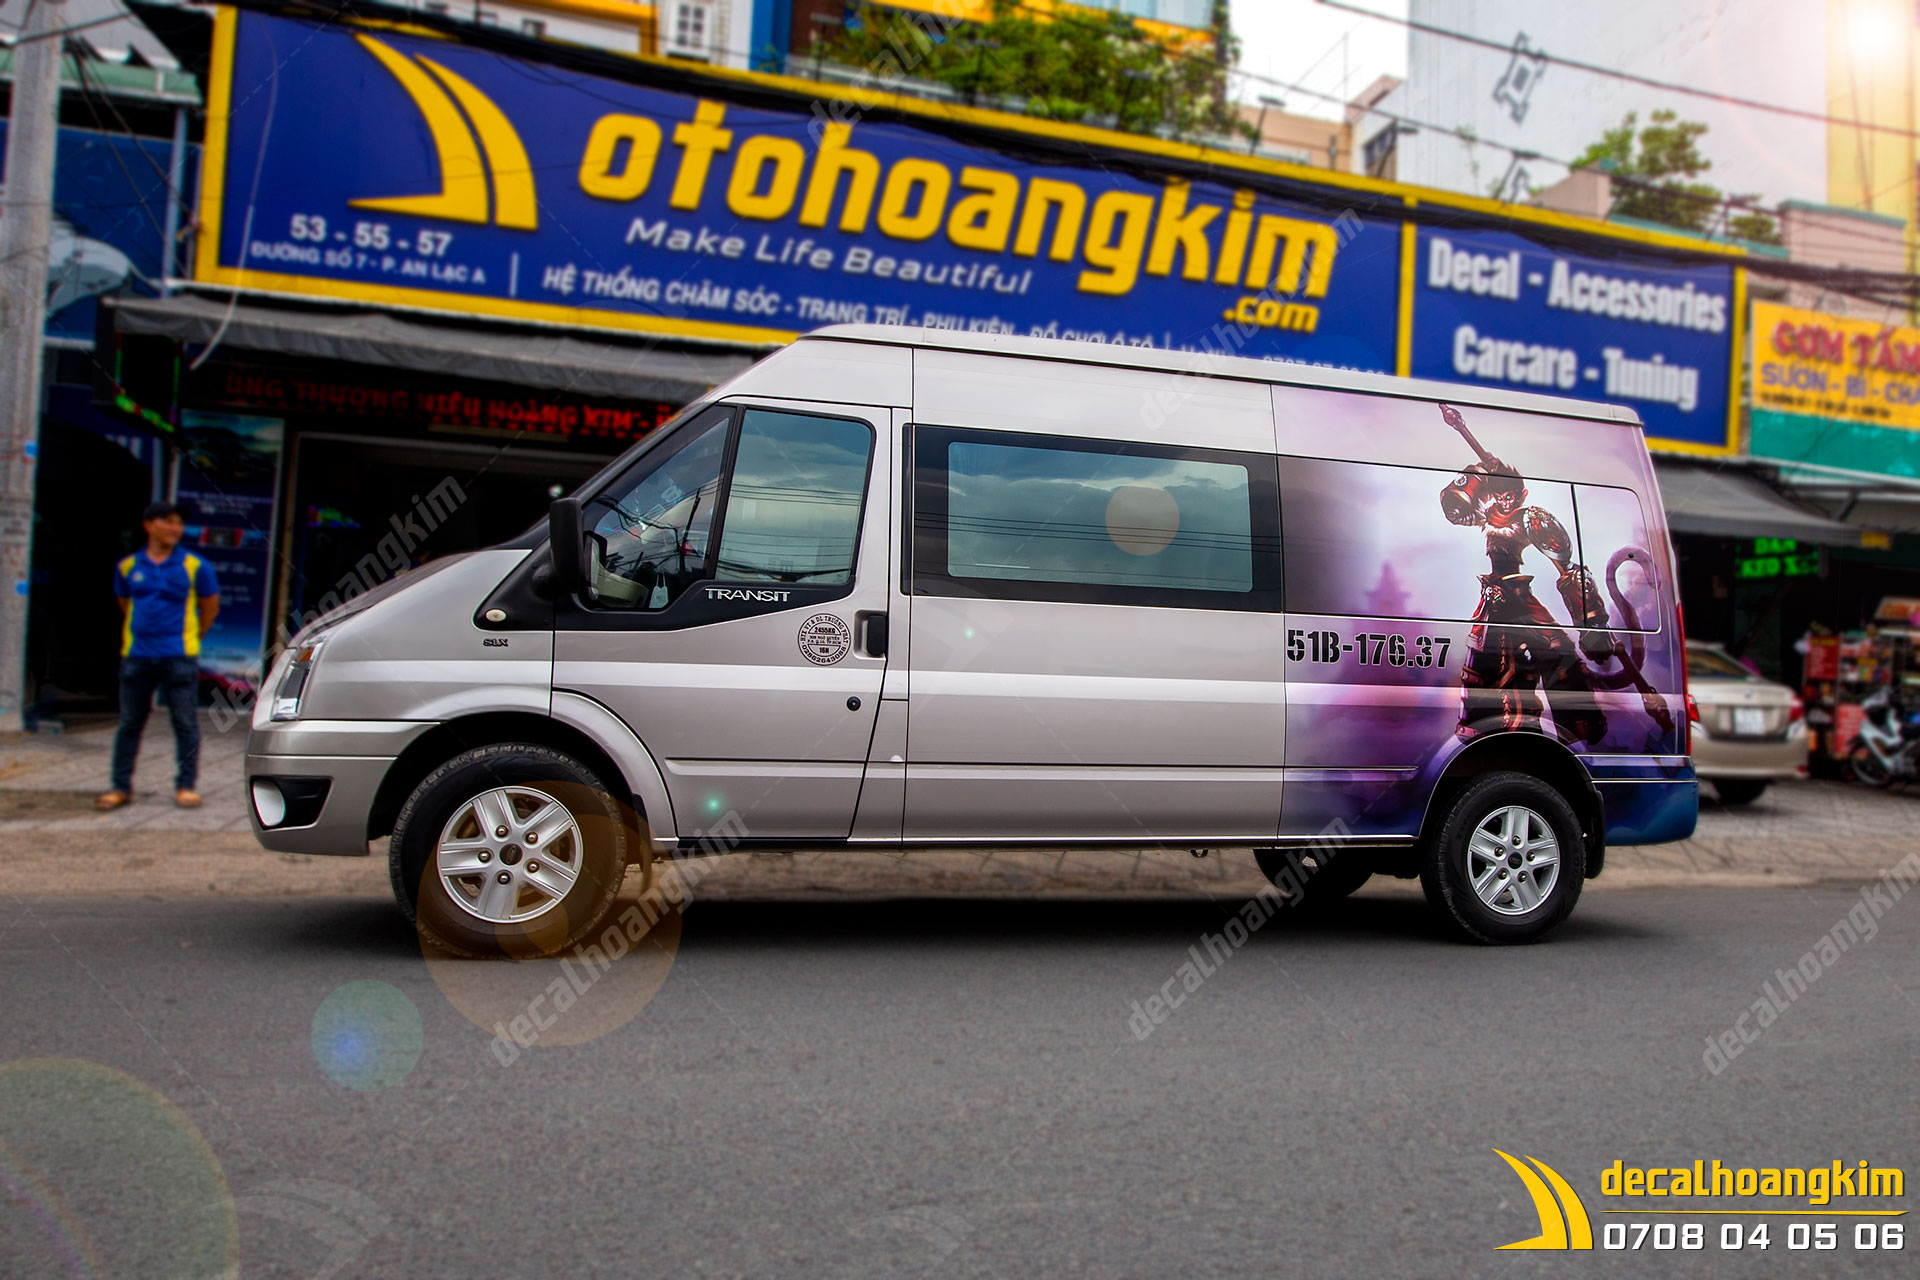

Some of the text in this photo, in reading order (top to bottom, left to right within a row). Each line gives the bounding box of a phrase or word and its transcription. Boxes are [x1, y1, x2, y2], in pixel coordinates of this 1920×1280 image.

[578, 99, 1338, 298] otohoangkim
[289, 214, 328, 242] 53
[354, 222, 390, 250] 55
[417, 230, 453, 256] 57
[624, 217, 1032, 294] Make Life Beautiful
[355, 253, 367, 270] 7
[401, 259, 428, 278] AN
[472, 267, 487, 285] A
[1429, 237, 1521, 300] Decal
[1546, 257, 1727, 334] Accessories
[543, 263, 577, 296] HỆ
[582, 265, 661, 302] THỐNG
[666, 279, 731, 309] CHĂM
[733, 284, 780, 315] SÓC
[797, 297, 868, 324] TRANG
[1223, 297, 1319, 332] .com
[1453, 324, 1577, 390] Carcare
[1603, 346, 1699, 412] Tuning
[705, 588, 791, 602] TRANSIT
[483, 638, 509, 648] SLX
[1286, 628, 1453, 668] 51B-176.37
